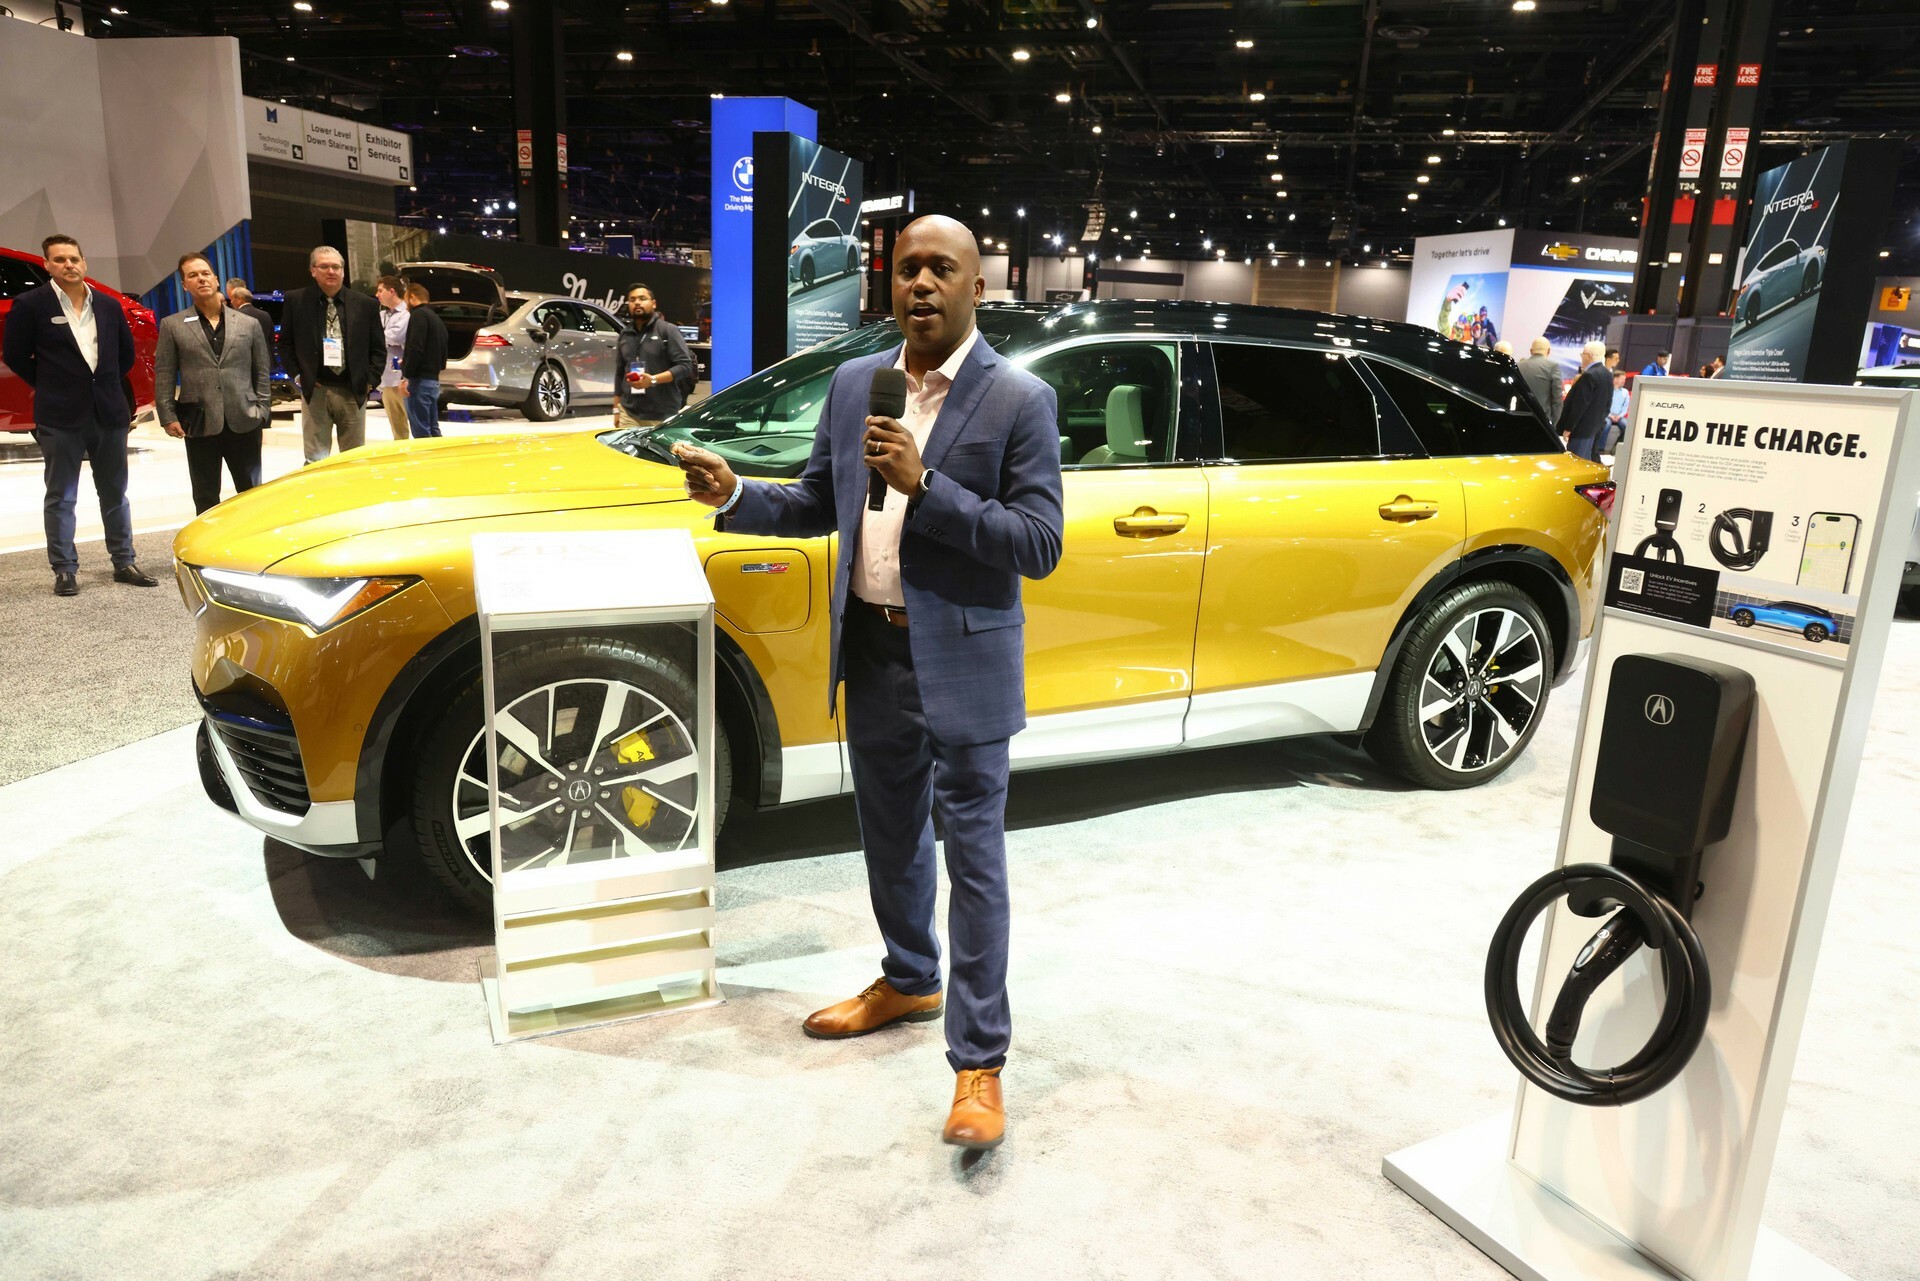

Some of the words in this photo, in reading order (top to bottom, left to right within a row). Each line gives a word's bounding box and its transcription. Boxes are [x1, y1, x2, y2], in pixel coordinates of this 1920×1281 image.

[1696, 67, 1714, 75] FIRE
[1740, 67, 1758, 75] FIRE
[1694, 76, 1714, 84] HOSE
[1737, 75, 1758, 84] HOSE
[311, 123, 332, 136] Lower
[334, 130, 352, 140] Level
[258, 133, 290, 148] Technology
[306, 134, 327, 147] Down
[328, 139, 358, 154] Stairway
[366, 133, 402, 150] Exhibitor
[263, 143, 288, 155] Services
[368, 148, 402, 164] Services
[802, 171, 847, 196] INTEGRA
[1679, 182, 1696, 190] T24
[1720, 182, 1737, 190] T24
[729, 195, 741, 203] The
[1763, 190, 1814, 216] INTEGRA
[724, 203, 744, 212] Driving
[1431, 250, 1458, 260] Together
[1459, 249, 1472, 257] let's
[1473, 247, 1489, 257] drive
[1655, 402, 1685, 410] ACURA
[1645, 417, 1699, 442] LEAD
[1706, 422, 1748, 448] THE
[1754, 426, 1867, 459] CHARGE.
[1698, 503, 1706, 513] 2
[1791, 515, 1800, 526] 3
[1650, 572, 1665, 580] Unlock
[1674, 577, 1697, 586] Incentives
